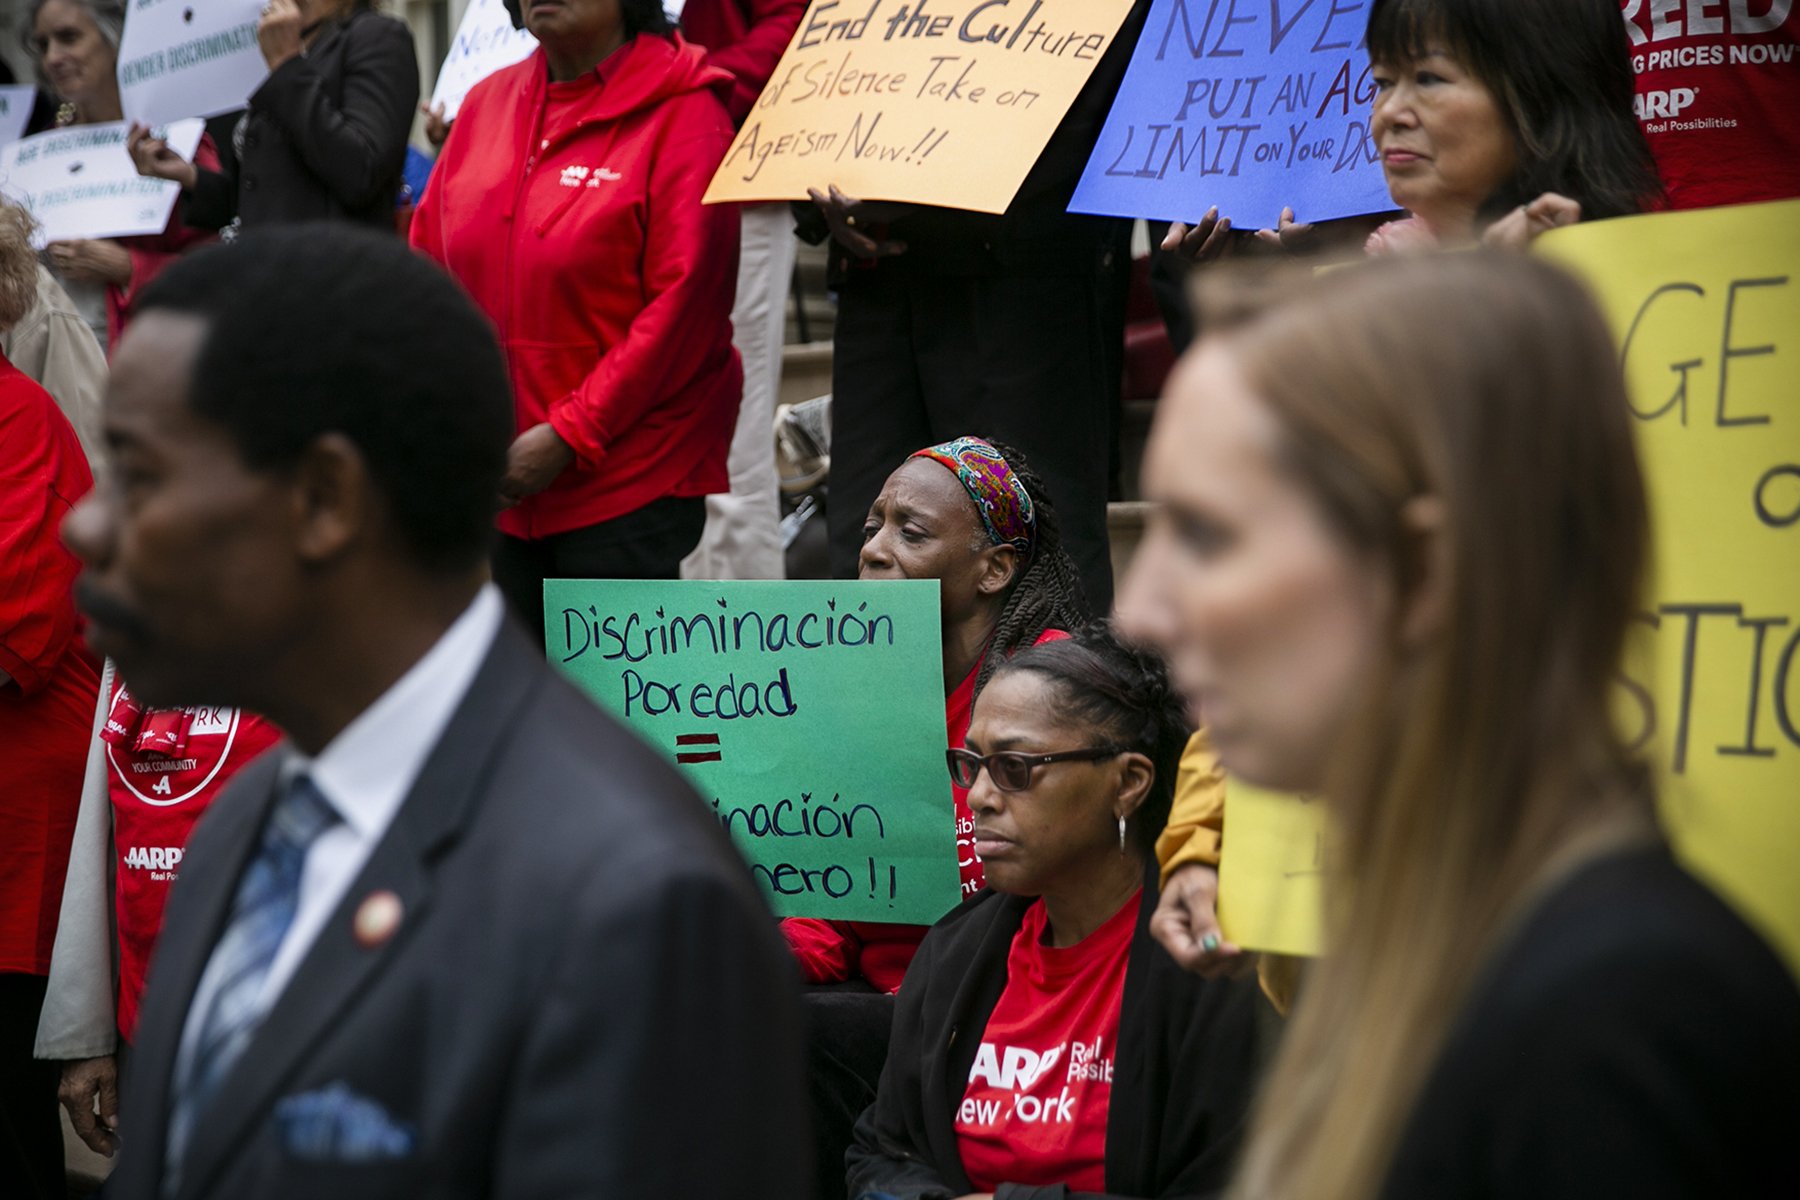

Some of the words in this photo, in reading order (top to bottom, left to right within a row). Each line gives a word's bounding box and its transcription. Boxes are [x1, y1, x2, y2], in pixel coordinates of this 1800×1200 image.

[798, 0, 879, 49] End
[884, 0, 952, 40] the
[958, 0, 1104, 60] Culture
[1154, 0, 1370, 61] NEVE
[758, 62, 803, 110] of
[791, 51, 907, 101] Silence
[916, 55, 986, 103] Take
[996, 88, 1040, 110] on
[1648, 45, 1724, 71] PRICES
[1729, 43, 1794, 64] NOW
[1173, 75, 1267, 121] PUT
[1268, 71, 1317, 116] AN
[725, 121, 837, 182] Ageism
[1105, 123, 1261, 180] LIMIT
[1254, 142, 1284, 163] ON
[1646, 120, 1668, 133] Real
[1669, 117, 1738, 132] Possibilities
[1622, 275, 1790, 427] GE
[152, 758, 197, 773] COMMUNITY
[124, 846, 183, 870] AARP
[955, 1096, 1001, 1127] ew
